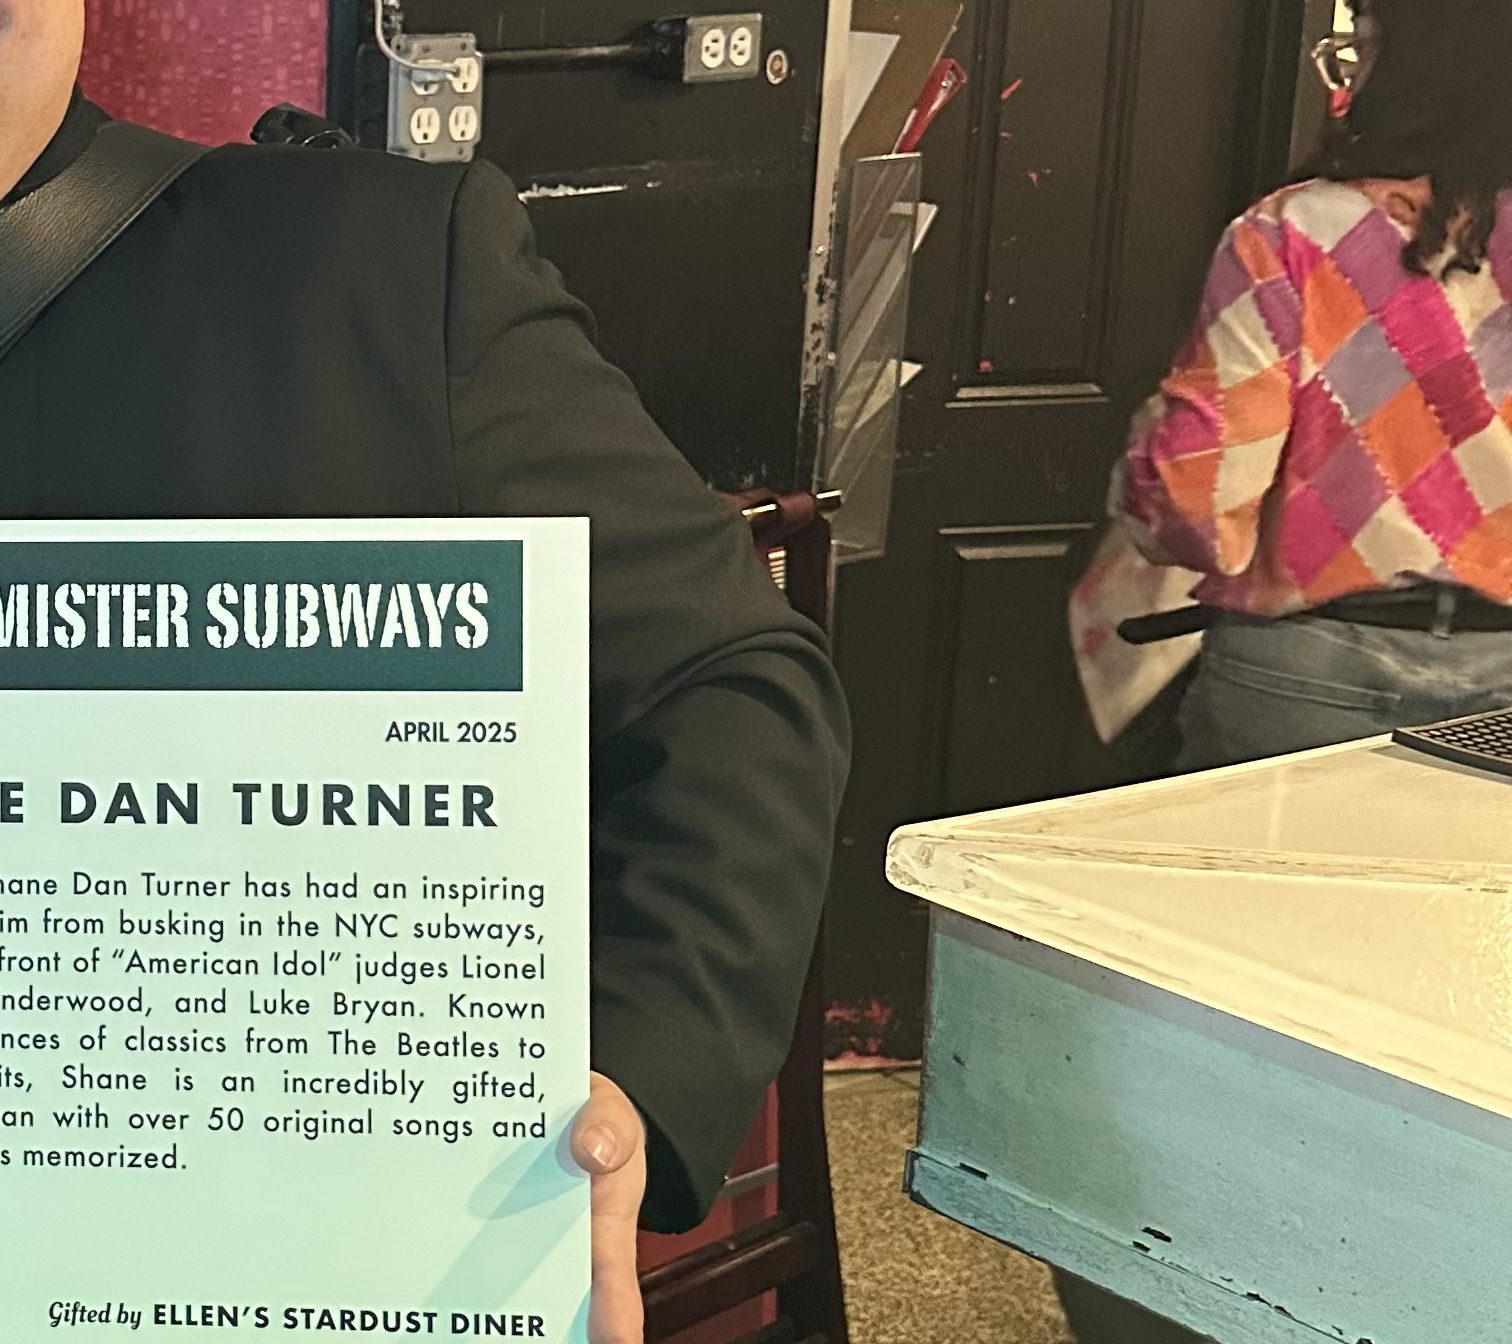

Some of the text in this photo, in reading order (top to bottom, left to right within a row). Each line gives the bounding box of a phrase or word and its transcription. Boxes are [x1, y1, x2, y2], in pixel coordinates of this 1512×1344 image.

[205, 582, 490, 649] SUBWAYS
[384, 720, 517, 744] APRIL 2025
[60, 781, 199, 825] DAN
[232, 782, 499, 828] TURNER
[73, 871, 127, 896] Dan
[140, 871, 232, 897] Turner
[244, 870, 292, 898] has
[306, 871, 358, 899] had
[373, 882, 407, 899] an
[422, 875, 545, 909] inspiring
[42, 907, 104, 935] from
[119, 908, 225, 944] busking
[239, 911, 263, 937] in
[276, 909, 320, 938] the
[335, 911, 399, 939] NYC
[413, 911, 544, 948] subways,
[72, 946, 101, 973] of
[111, 948, 259, 976] "American
[273, 949, 342, 977] Idol"
[355, 950, 449, 986] judges
[462, 952, 545, 980] Lionel
[174, 987, 227, 1014] and
[249, 987, 311, 1016] Luke
[333, 991, 425, 1024] Bryan.
[448, 993, 545, 1020] Known
[79, 1023, 107, 1051] of
[124, 1024, 227, 1053] classics
[245, 1026, 308, 1055] from
[327, 1028, 377, 1056] The
[397, 1030, 500, 1059] Beatles
[518, 1036, 546, 1060] to
[61, 1062, 147, 1091] Shane
[174, 1066, 194, 1092] is
[221, 1075, 255, 1093] an
[283, 1067, 425, 1104] incredibly
[452, 1070, 545, 1105] gifted,
[52, 1101, 109, 1129] with
[127, 1112, 191, 1131] over
[207, 1106, 244, 1132] 50
[263, 1107, 373, 1141] original
[392, 1118, 473, 1144] songs
[492, 1111, 546, 1139] and
[23, 1142, 187, 1170] memorized.
[48, 1300, 546, 1338] Gifted by ELLEN'S STARDUST DINER
